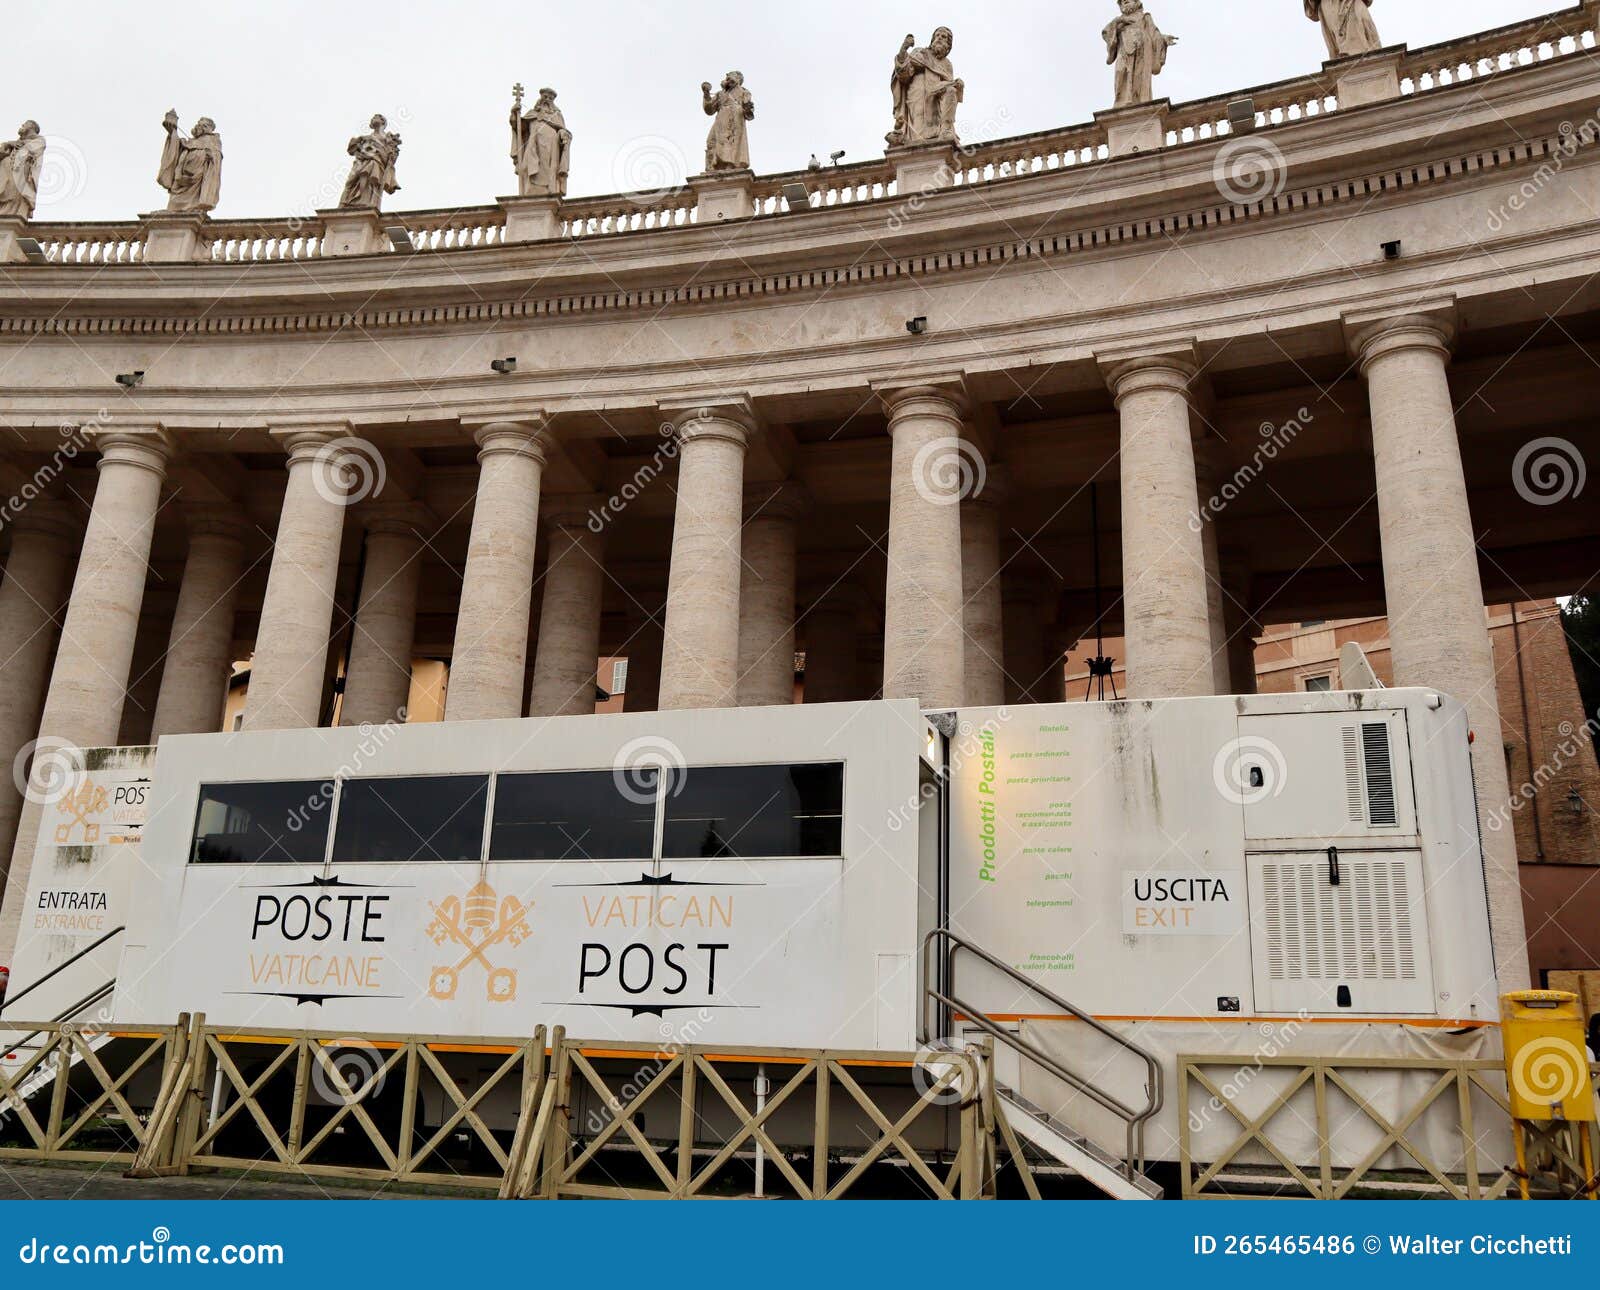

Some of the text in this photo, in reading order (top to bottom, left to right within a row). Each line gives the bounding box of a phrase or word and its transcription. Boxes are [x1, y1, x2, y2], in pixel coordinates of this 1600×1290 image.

[114, 787, 151, 805] POS
[978, 728, 996, 882] Prodotti Postali
[38, 891, 107, 910] ENTRATA
[1134, 879, 1229, 901] USCITA
[34, 913, 105, 930] ENTRANCE
[251, 895, 390, 942] POSTE
[582, 896, 734, 928] VATICAN
[1135, 907, 1195, 927] EXIT
[250, 953, 384, 987] VATICANE
[579, 943, 729, 995] POST
